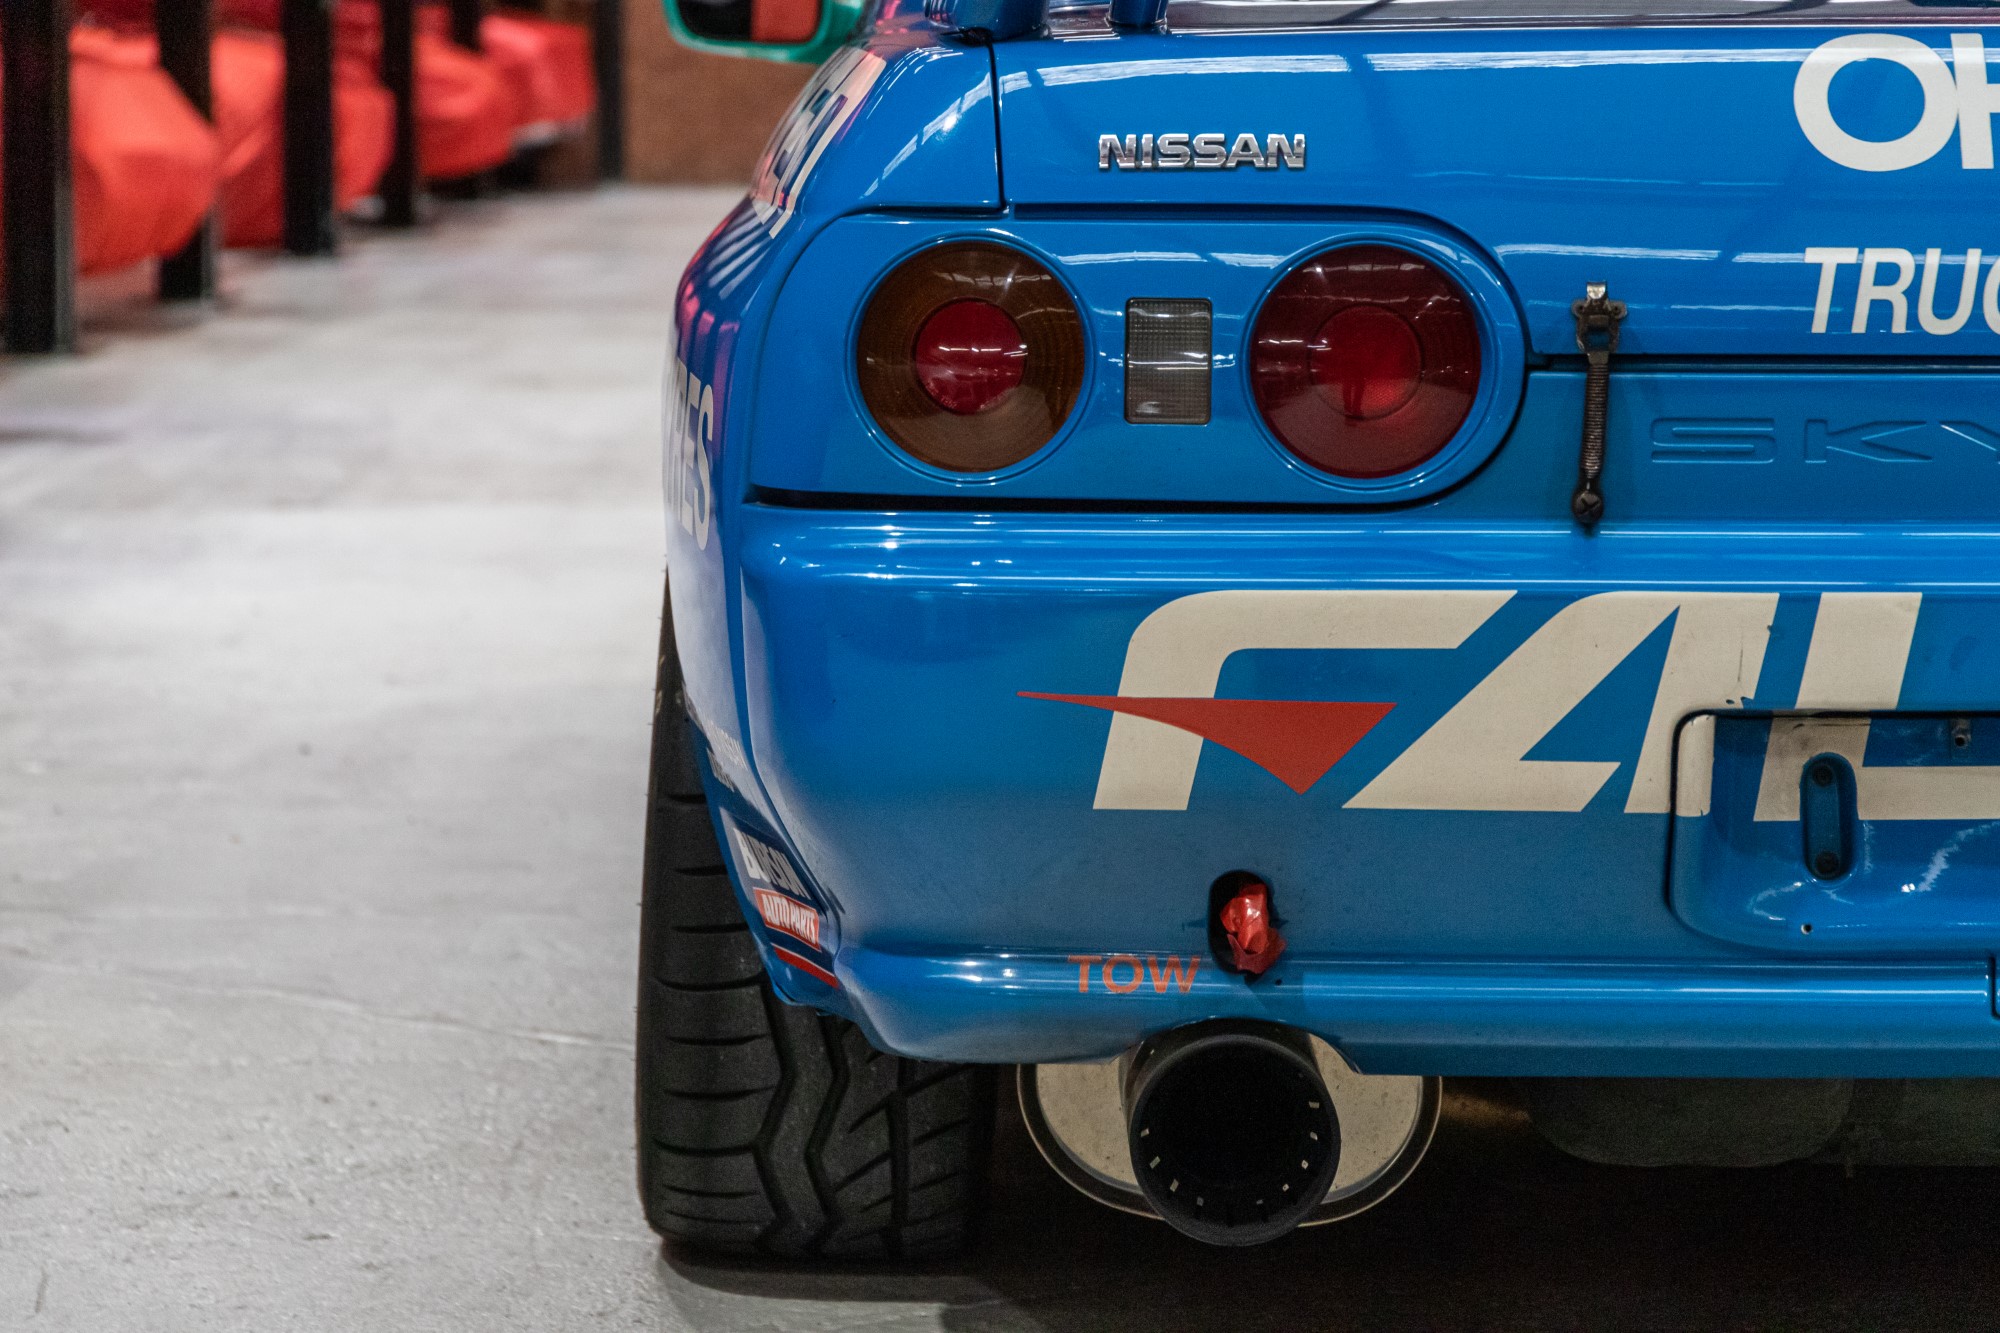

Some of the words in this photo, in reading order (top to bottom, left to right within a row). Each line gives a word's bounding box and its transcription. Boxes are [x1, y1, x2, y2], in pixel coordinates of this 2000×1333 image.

[1098, 132, 1306, 170] NISSAN
[761, 893, 791, 930] AUTO
[789, 901, 816, 945] PARTS
[1068, 955, 1200, 994] TOW
